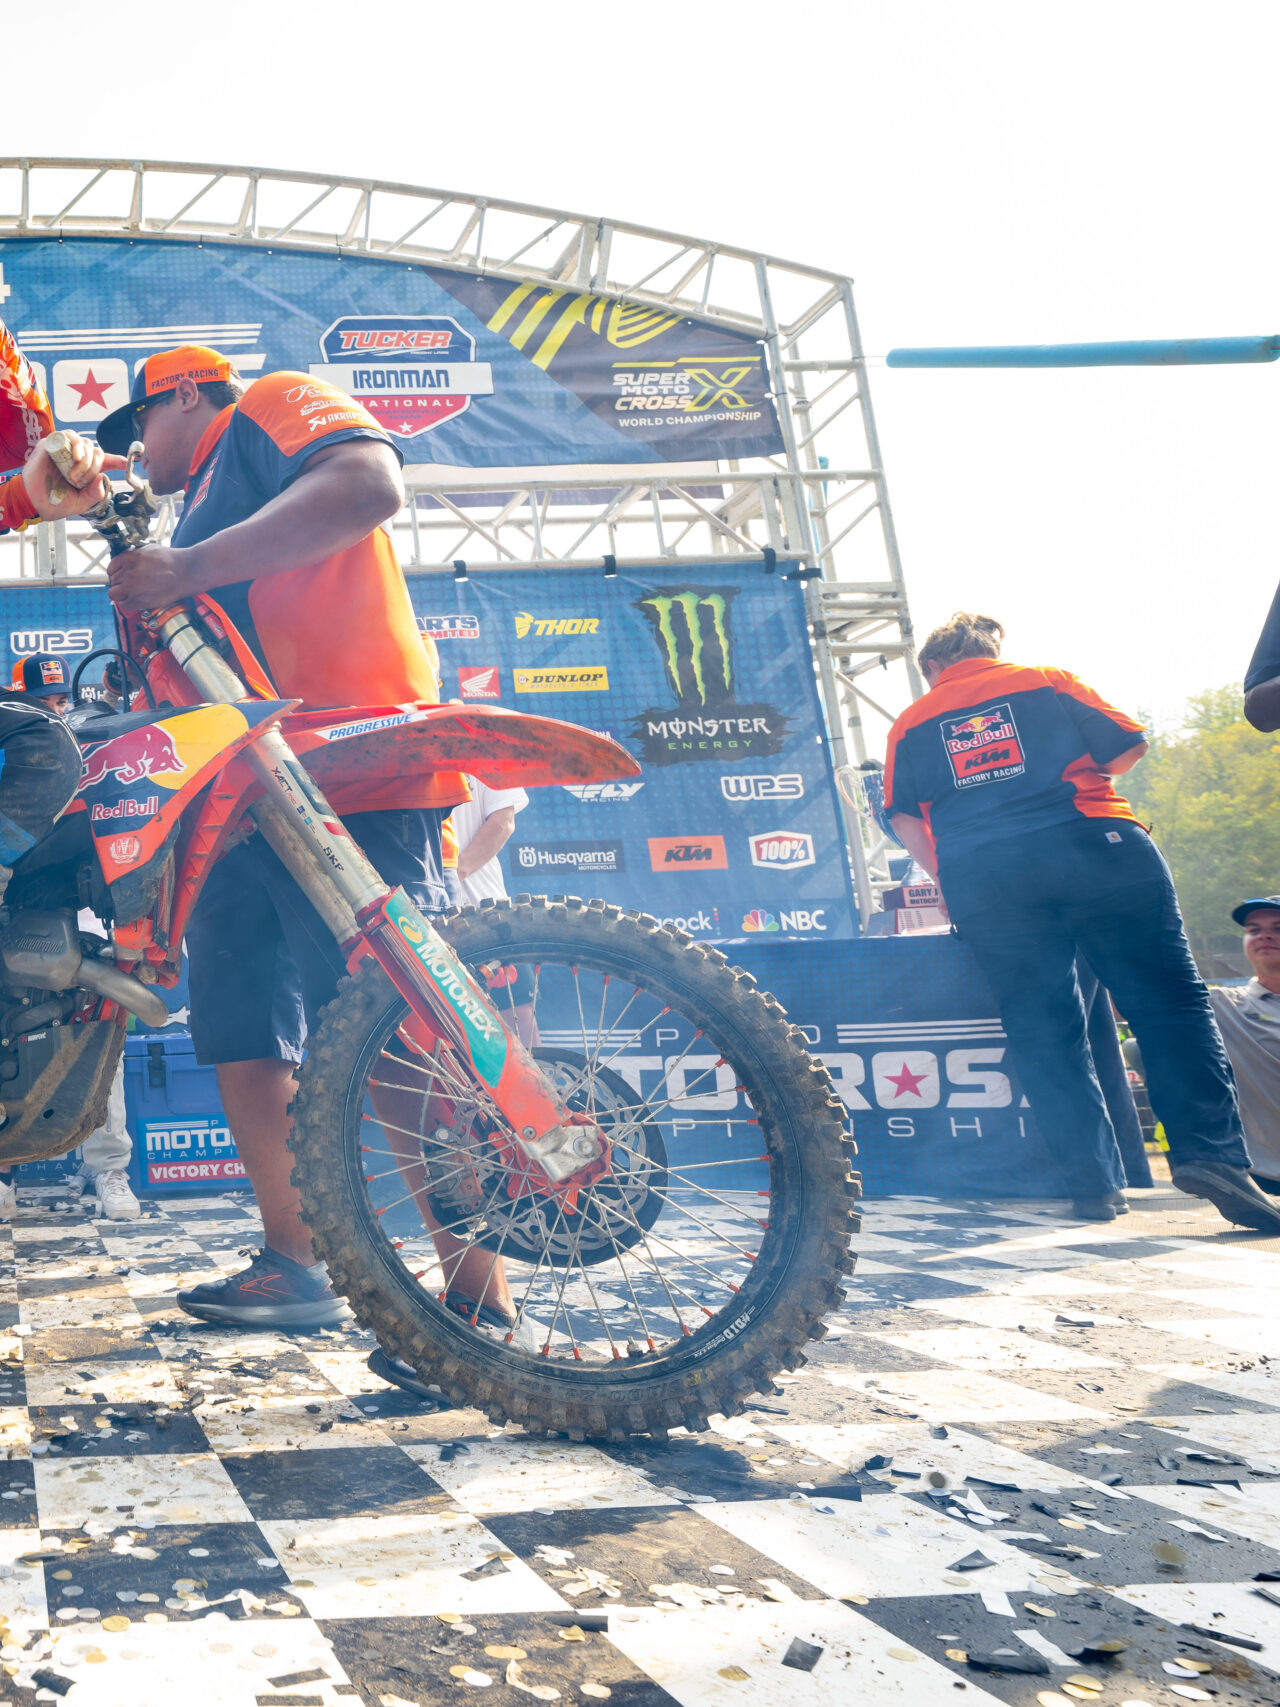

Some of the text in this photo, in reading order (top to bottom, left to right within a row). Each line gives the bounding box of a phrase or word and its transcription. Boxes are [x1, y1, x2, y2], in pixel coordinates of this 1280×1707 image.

[338, 330, 453, 349] TUCKER
[151, 368, 219, 390] FACTORY RACING
[352, 369, 450, 389] IRONMAN
[612, 372, 691, 385] SUPER
[621, 385, 690, 396] MOTO
[615, 395, 695, 411] CROSS
[618, 411, 762, 427] WORLD CHAMPIONSHIP
[533, 618, 600, 636] THOR
[10, 629, 94, 656] WPS
[531, 673, 604, 684] DUNLOP
[328, 713, 412, 741] PROGRESSIVE
[647, 716, 772, 739] MONSTER
[667, 740, 753, 750] ENERGY
[947, 722, 1015, 754] Red Bull
[964, 748, 1011, 770] KTM
[721, 774, 805, 800] WPS
[958, 771, 991, 787] FACTORY
[92, 796, 159, 821] Red Bull
[323, 847, 345, 872] SKF
[538, 850, 616, 865] Husqvarna
[664, 845, 712, 862] KTM
[759, 840, 806, 862] 100%
[780, 909, 828, 931] NBC
[415, 942, 500, 1041] MOTOREX
[151, 1163, 220, 1179] VICTORY
